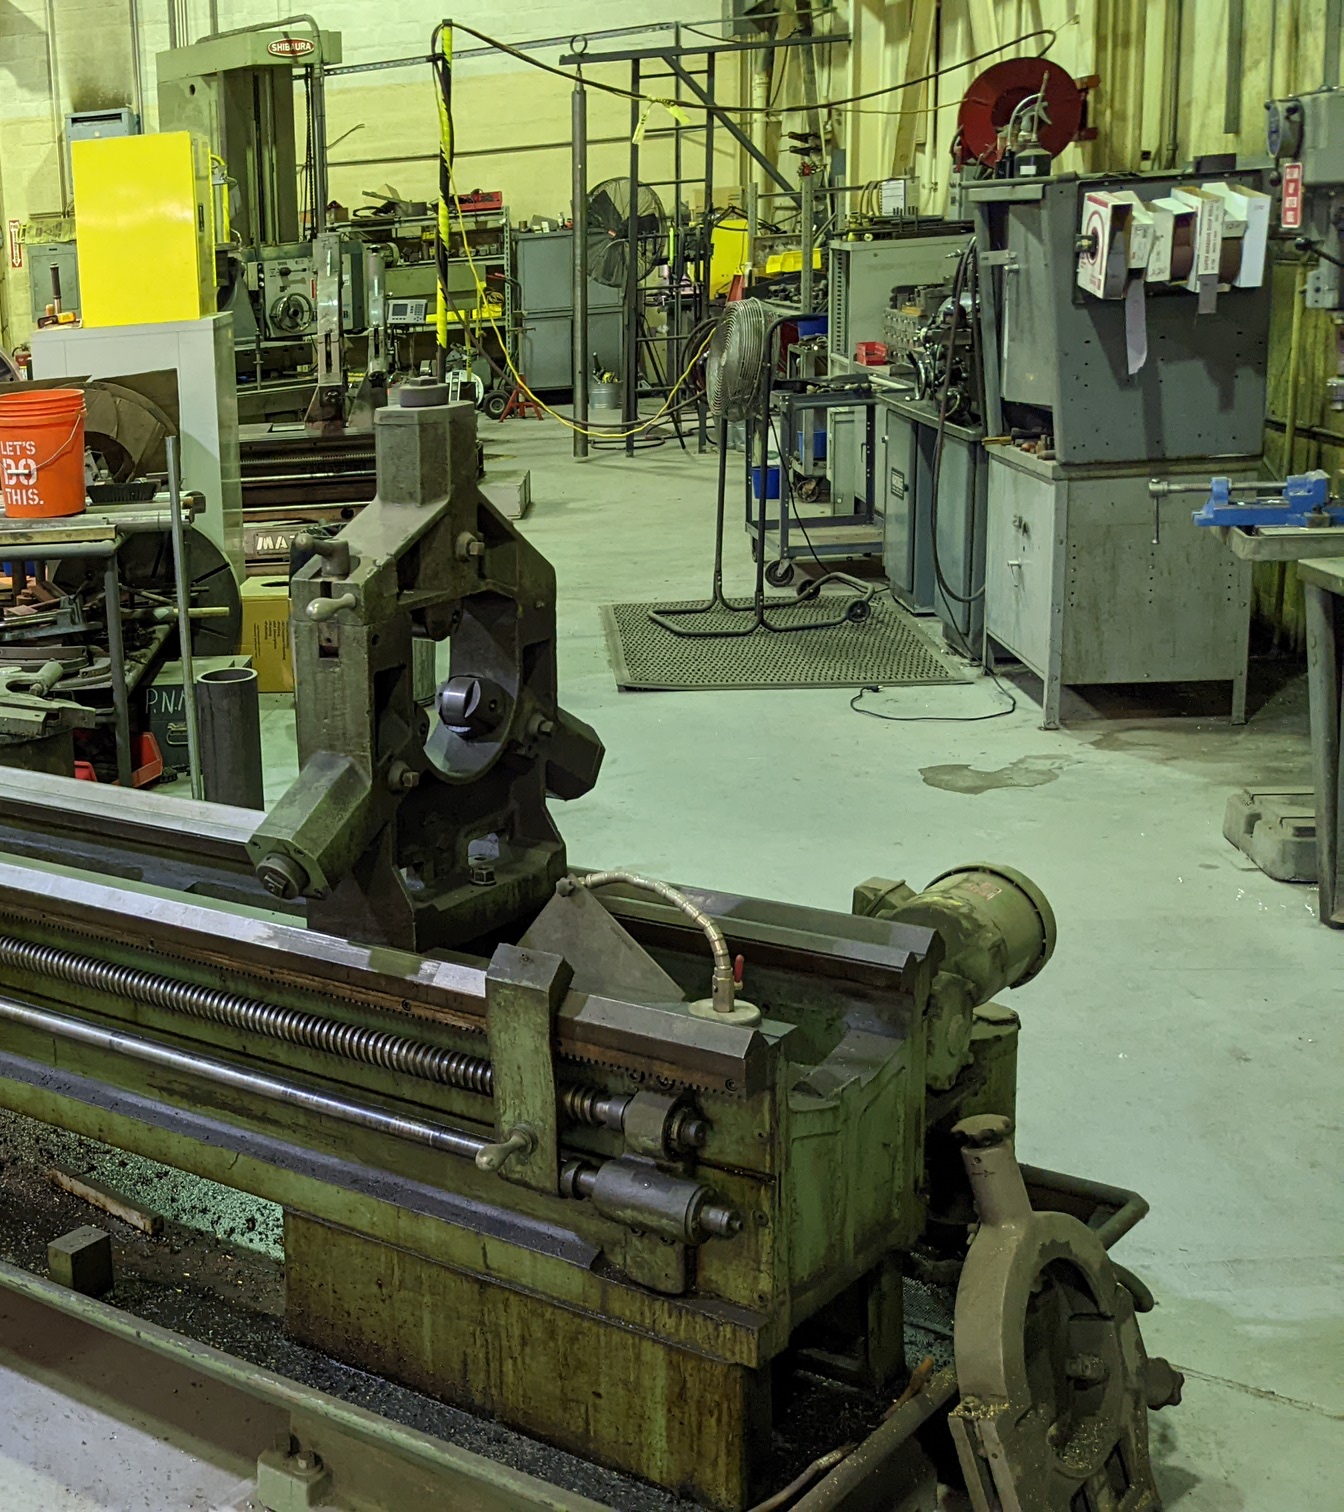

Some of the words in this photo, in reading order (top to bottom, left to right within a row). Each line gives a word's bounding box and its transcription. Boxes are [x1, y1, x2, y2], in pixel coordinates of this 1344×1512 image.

[271, 42, 312, 52] SHIBAURA
[0, 440, 36, 456] LET'S
[2, 458, 38, 486] DO
[5, 488, 45, 505] THIS.
[256, 535, 296, 551] MA
